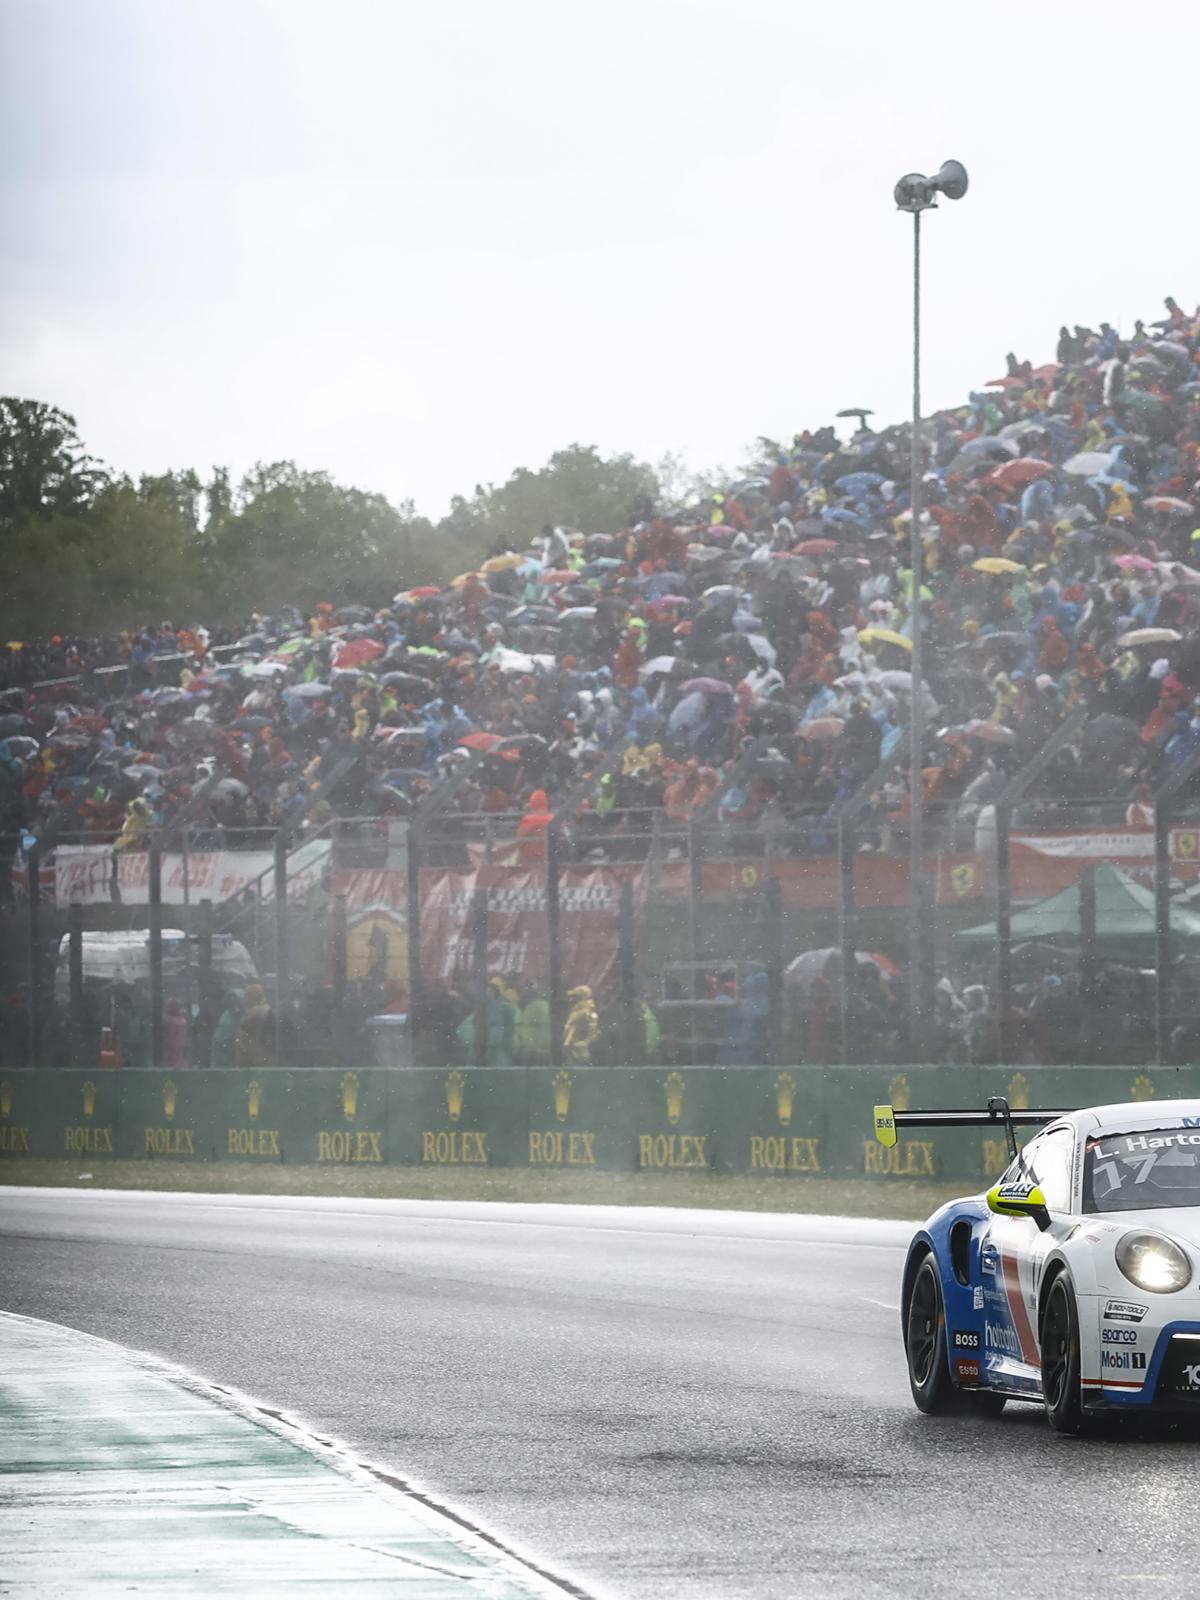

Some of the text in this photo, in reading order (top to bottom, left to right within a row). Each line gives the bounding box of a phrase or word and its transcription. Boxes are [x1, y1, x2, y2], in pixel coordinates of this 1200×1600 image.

[0, 1127, 29, 1151] LEX
[65, 1128, 112, 1151] ROLEX
[144, 1128, 194, 1153] ROLEX
[228, 1129, 280, 1155] ROLEX
[319, 1132, 383, 1161] ROLEX
[423, 1132, 487, 1162] ROLEX
[529, 1132, 596, 1164] ROLEX
[639, 1134, 710, 1168] ROLEX
[751, 1136, 822, 1172] ROLEX
[863, 1140, 936, 1176] ROLEX
[1094, 1145, 1119, 1160] L.
[1093, 1153, 1158, 1190] 17
[1001, 1183, 1034, 1192] PIN
[955, 1334, 978, 1346] BOSS
[1102, 1328, 1137, 1342] sparco
[1101, 1351, 1144, 1368] Mobil 1
